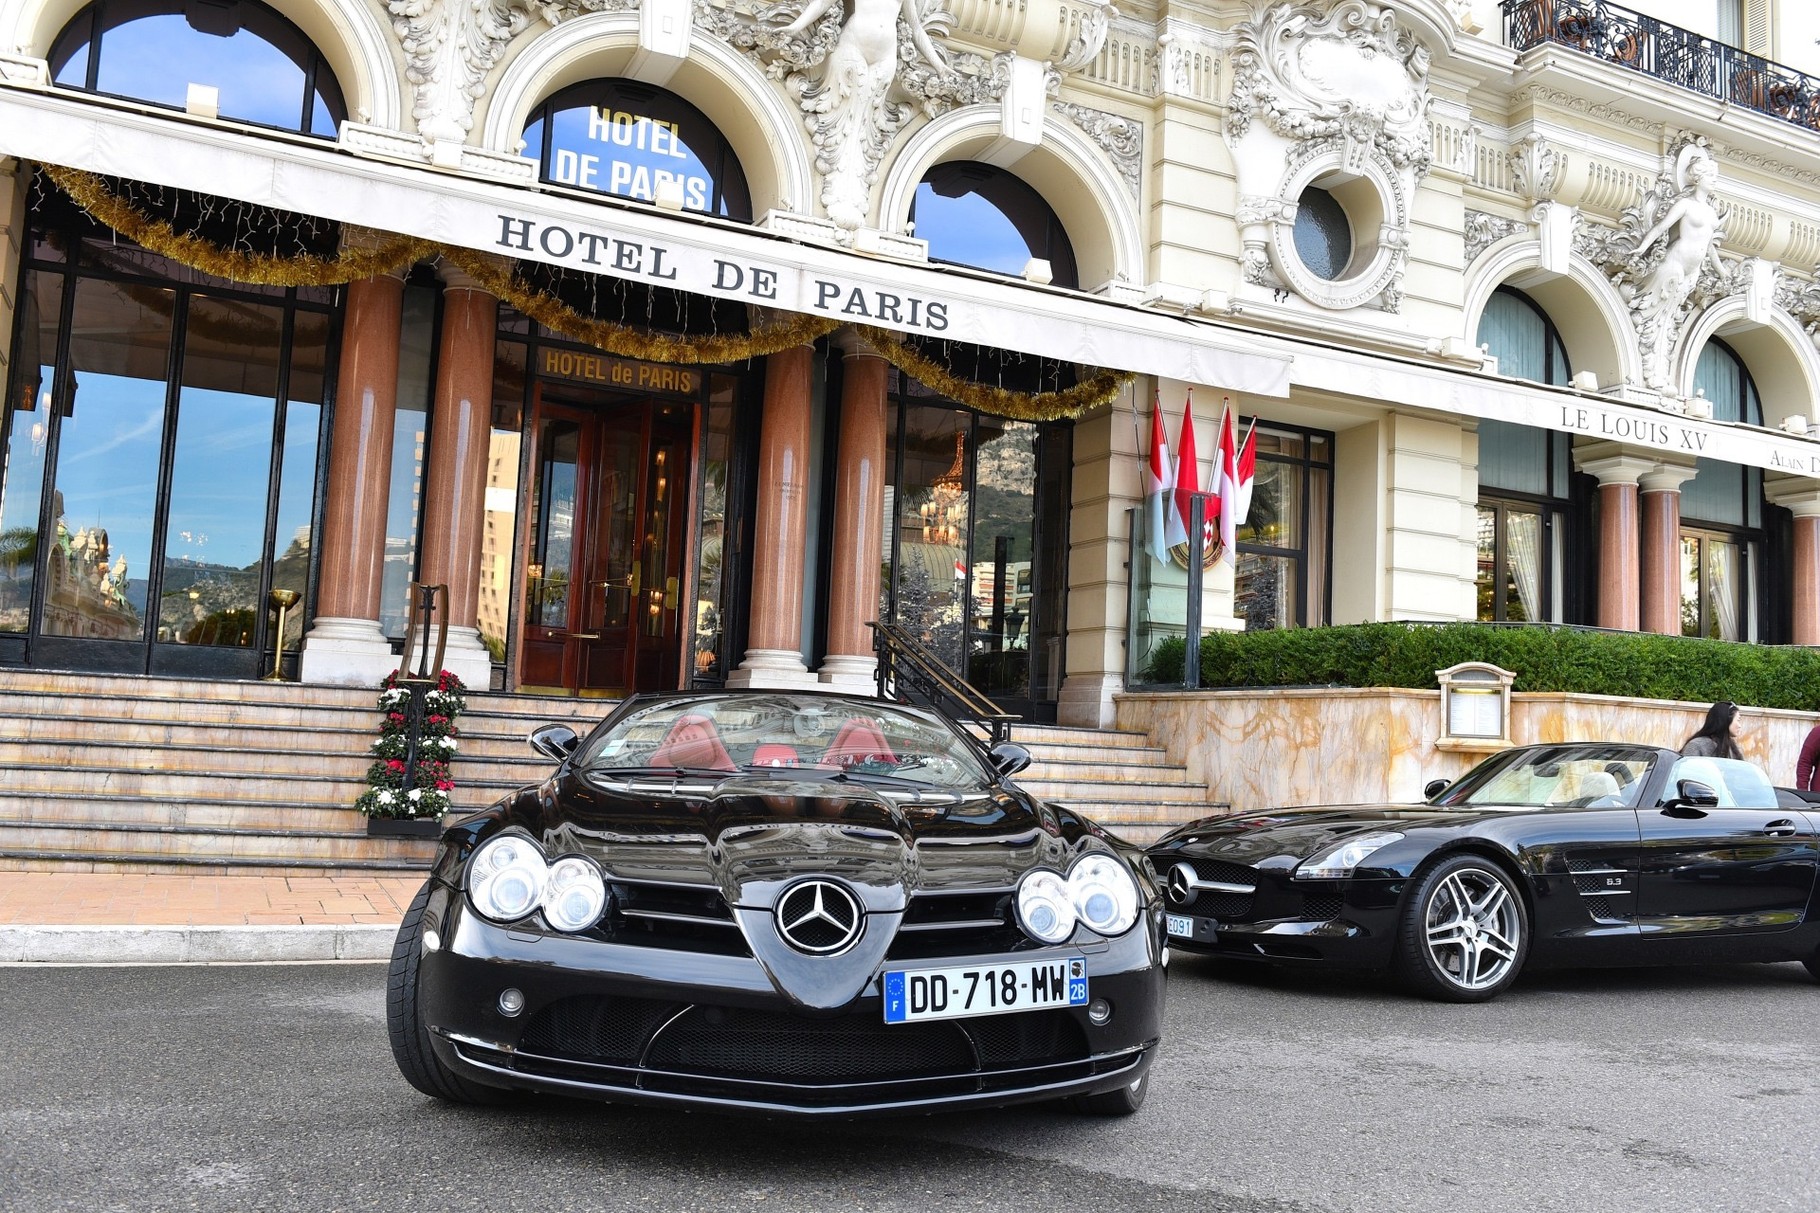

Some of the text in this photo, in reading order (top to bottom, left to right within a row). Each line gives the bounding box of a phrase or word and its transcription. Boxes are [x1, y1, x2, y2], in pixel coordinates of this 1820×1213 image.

[588, 105, 687, 159] HOTEL
[555, 148, 598, 190] DE
[495, 214, 949, 331] HOTEL DE PARIS
[546, 350, 691, 393] HOTEL de PARIS
[1561, 406, 1708, 451] LE LOUIS XV
[892, 1000, 899, 1012] F
[910, 964, 1065, 1014] DD-718-MW
[1070, 983, 1086, 1001] 2B
